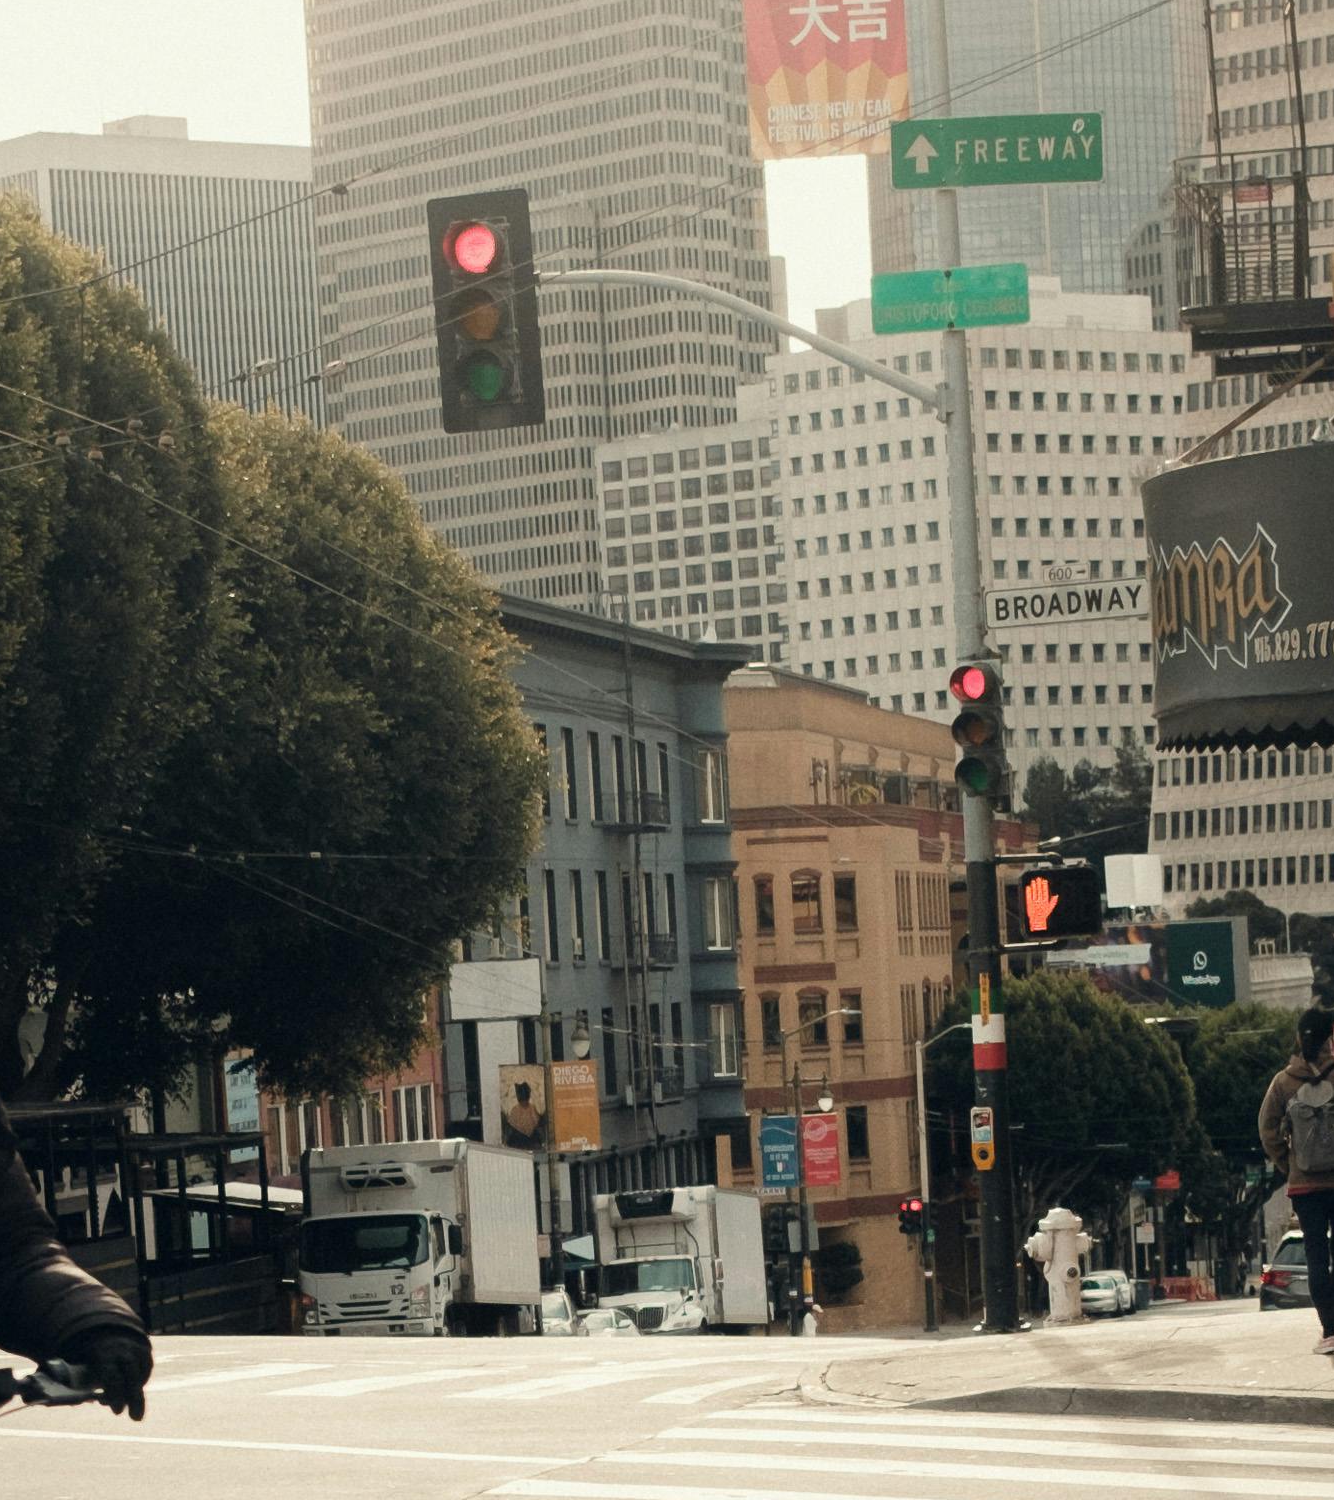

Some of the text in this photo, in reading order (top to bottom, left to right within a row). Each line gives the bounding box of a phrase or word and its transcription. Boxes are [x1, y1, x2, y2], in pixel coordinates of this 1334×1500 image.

[768, 99, 891, 122] CHINESE NEW YEAR
[768, 122, 826, 143] FESTIVAL
[955, 135, 1095, 164] FREEWAY
[1048, 567, 1072, 581] 600
[995, 585, 1142, 621] BROADWAY
[552, 1065, 589, 1076] DIEGO
[554, 1075, 594, 1085] RIVERA
